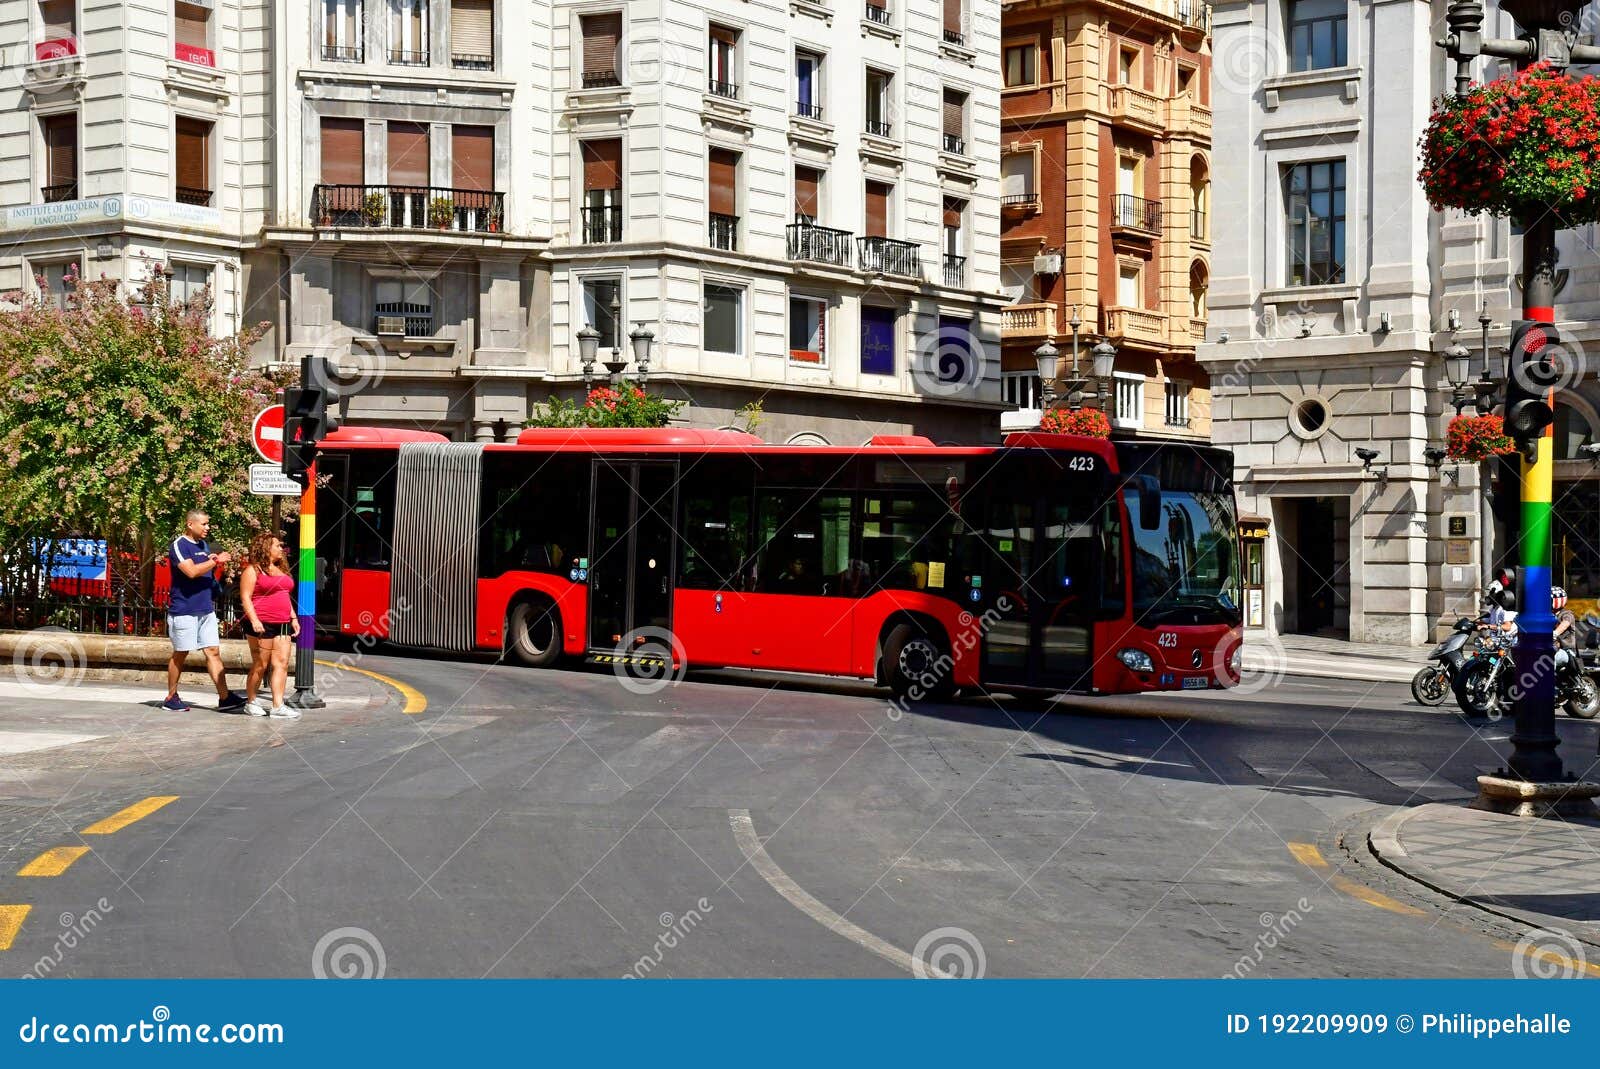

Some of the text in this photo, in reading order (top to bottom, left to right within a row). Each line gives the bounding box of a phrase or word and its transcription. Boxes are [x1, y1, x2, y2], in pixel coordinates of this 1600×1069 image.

[188, 51, 209, 67] real
[13, 200, 100, 218] INSTITUTE OF MODERN
[34, 214, 79, 225] LANGUAGES
[1069, 456, 1094, 471] 423
[1158, 632, 1177, 648] 423
